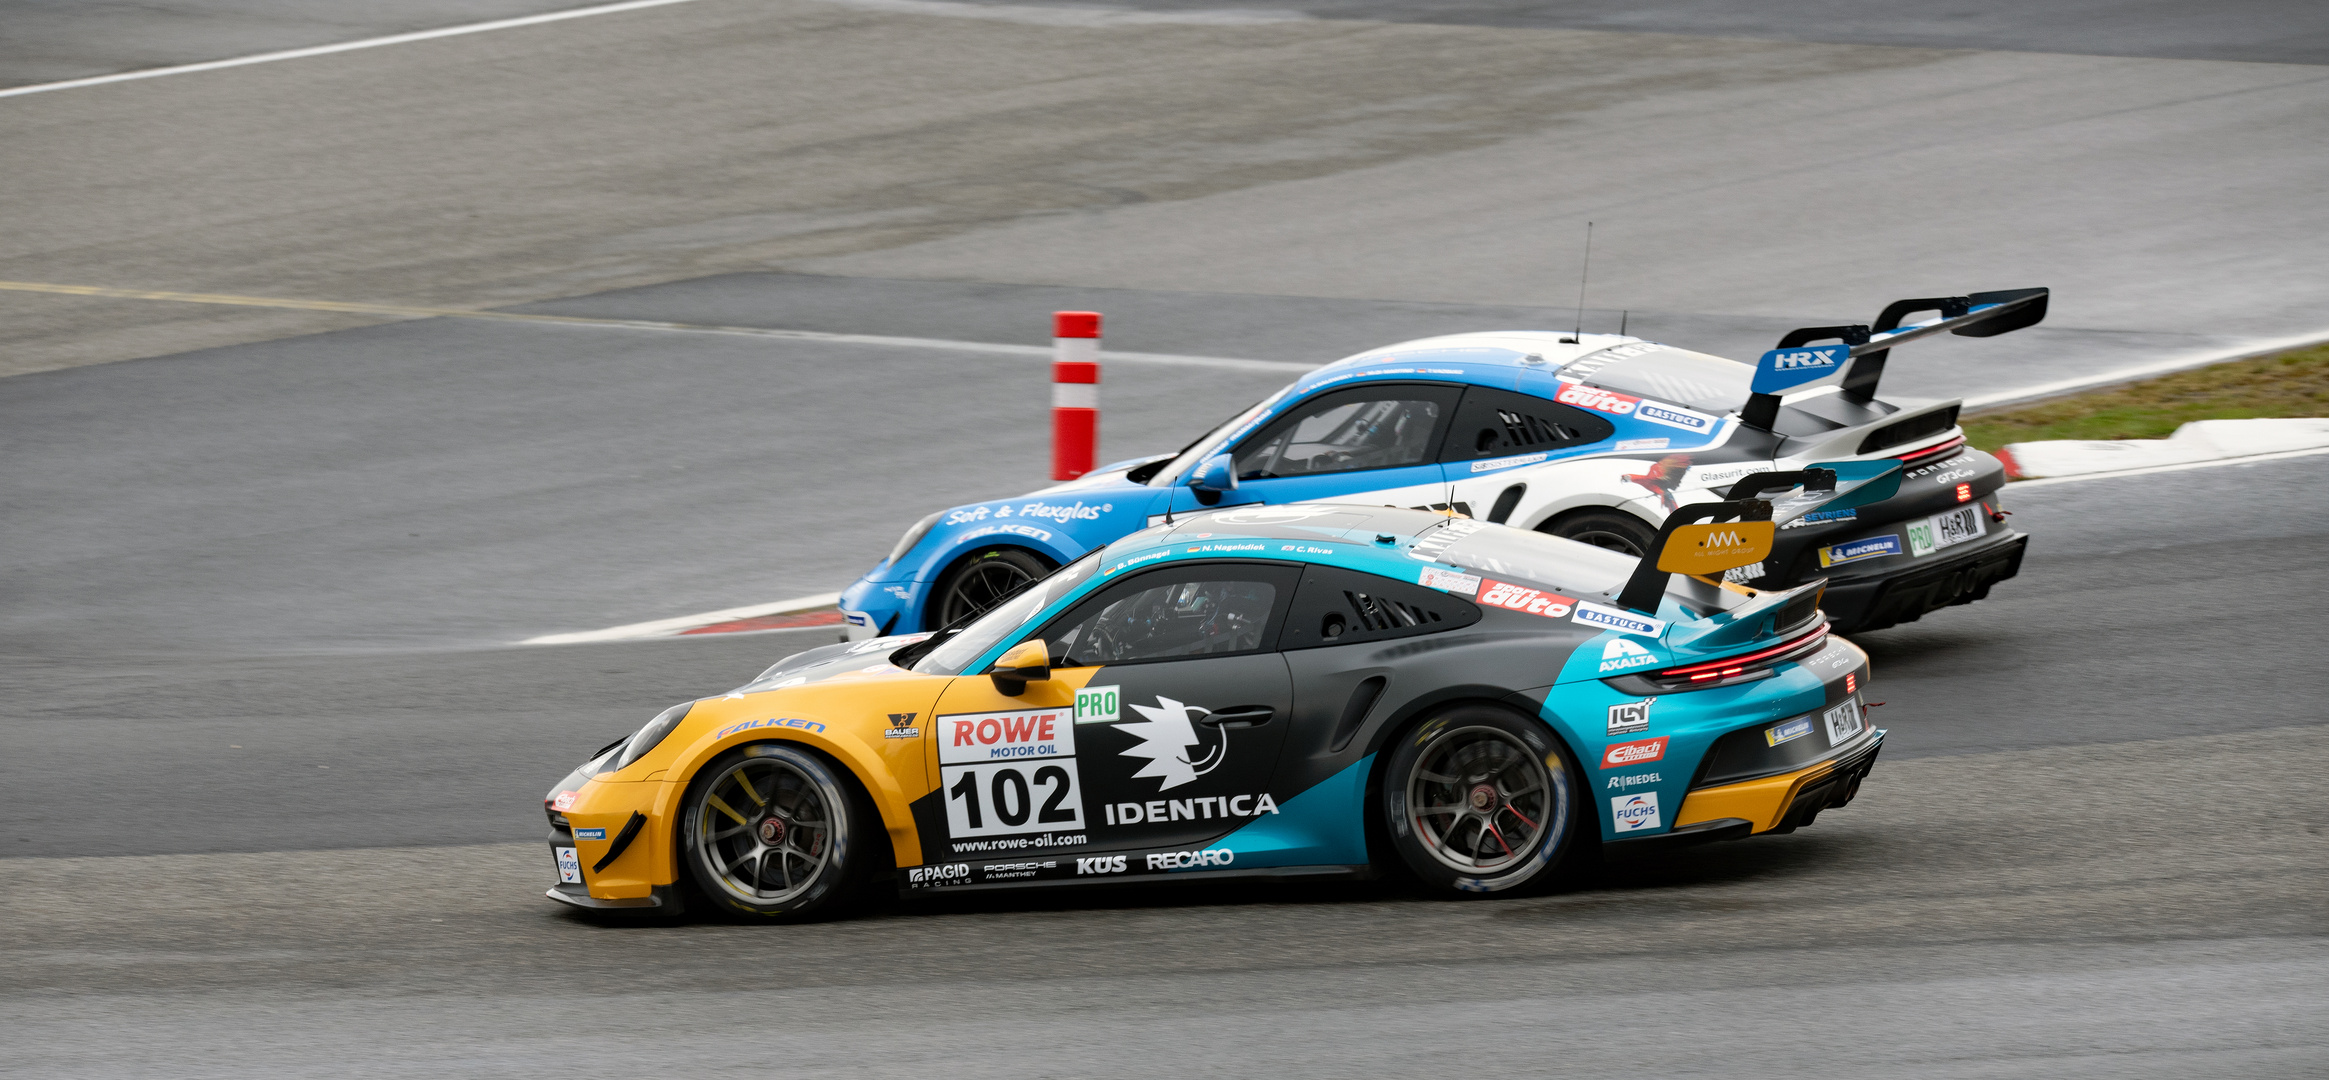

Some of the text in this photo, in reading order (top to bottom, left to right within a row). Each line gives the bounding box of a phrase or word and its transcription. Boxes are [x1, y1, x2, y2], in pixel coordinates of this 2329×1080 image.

[1775, 349, 1836, 368] HRX
[1559, 390, 1636, 414] auto
[1646, 408, 1700, 427] BASTUCK
[1701, 467, 1770, 482] Glasurit.com
[1906, 456, 1976, 479] PORSCHE
[946, 506, 991, 525] Soft
[994, 505, 1014, 518] &
[1804, 508, 1857, 522] SEVRIENS
[956, 524, 1052, 545] FALKEN
[1909, 525, 1932, 551] PRO
[1307, 546, 1333, 555] Rivas
[1846, 541, 1894, 556] MICHELIN
[1492, 583, 1541, 598] sport
[1482, 589, 1571, 618] auto
[1586, 611, 1646, 632] BASTUCK
[1599, 654, 1659, 672] AXALTA
[1077, 691, 1117, 718] PRO
[716, 717, 826, 740] FALKEN
[885, 727, 919, 736] BAUER
[990, 744, 1058, 758] MOTOR OIL
[1607, 741, 1661, 763] Eibach
[1626, 772, 1662, 786] RIEDEL
[950, 765, 1077, 829] 102
[1105, 793, 1280, 826] IDENTICA
[1616, 803, 1656, 819] FUCHS
[952, 833, 1088, 853] www.rowe-oil.com
[560, 860, 578, 870] FUCHS
[984, 861, 1057, 872] PORSCHE
[1146, 848, 1234, 871] RECARO
[924, 863, 970, 880] PAGID
[995, 871, 1036, 879] MANTHEY
[911, 878, 972, 889] RACING
